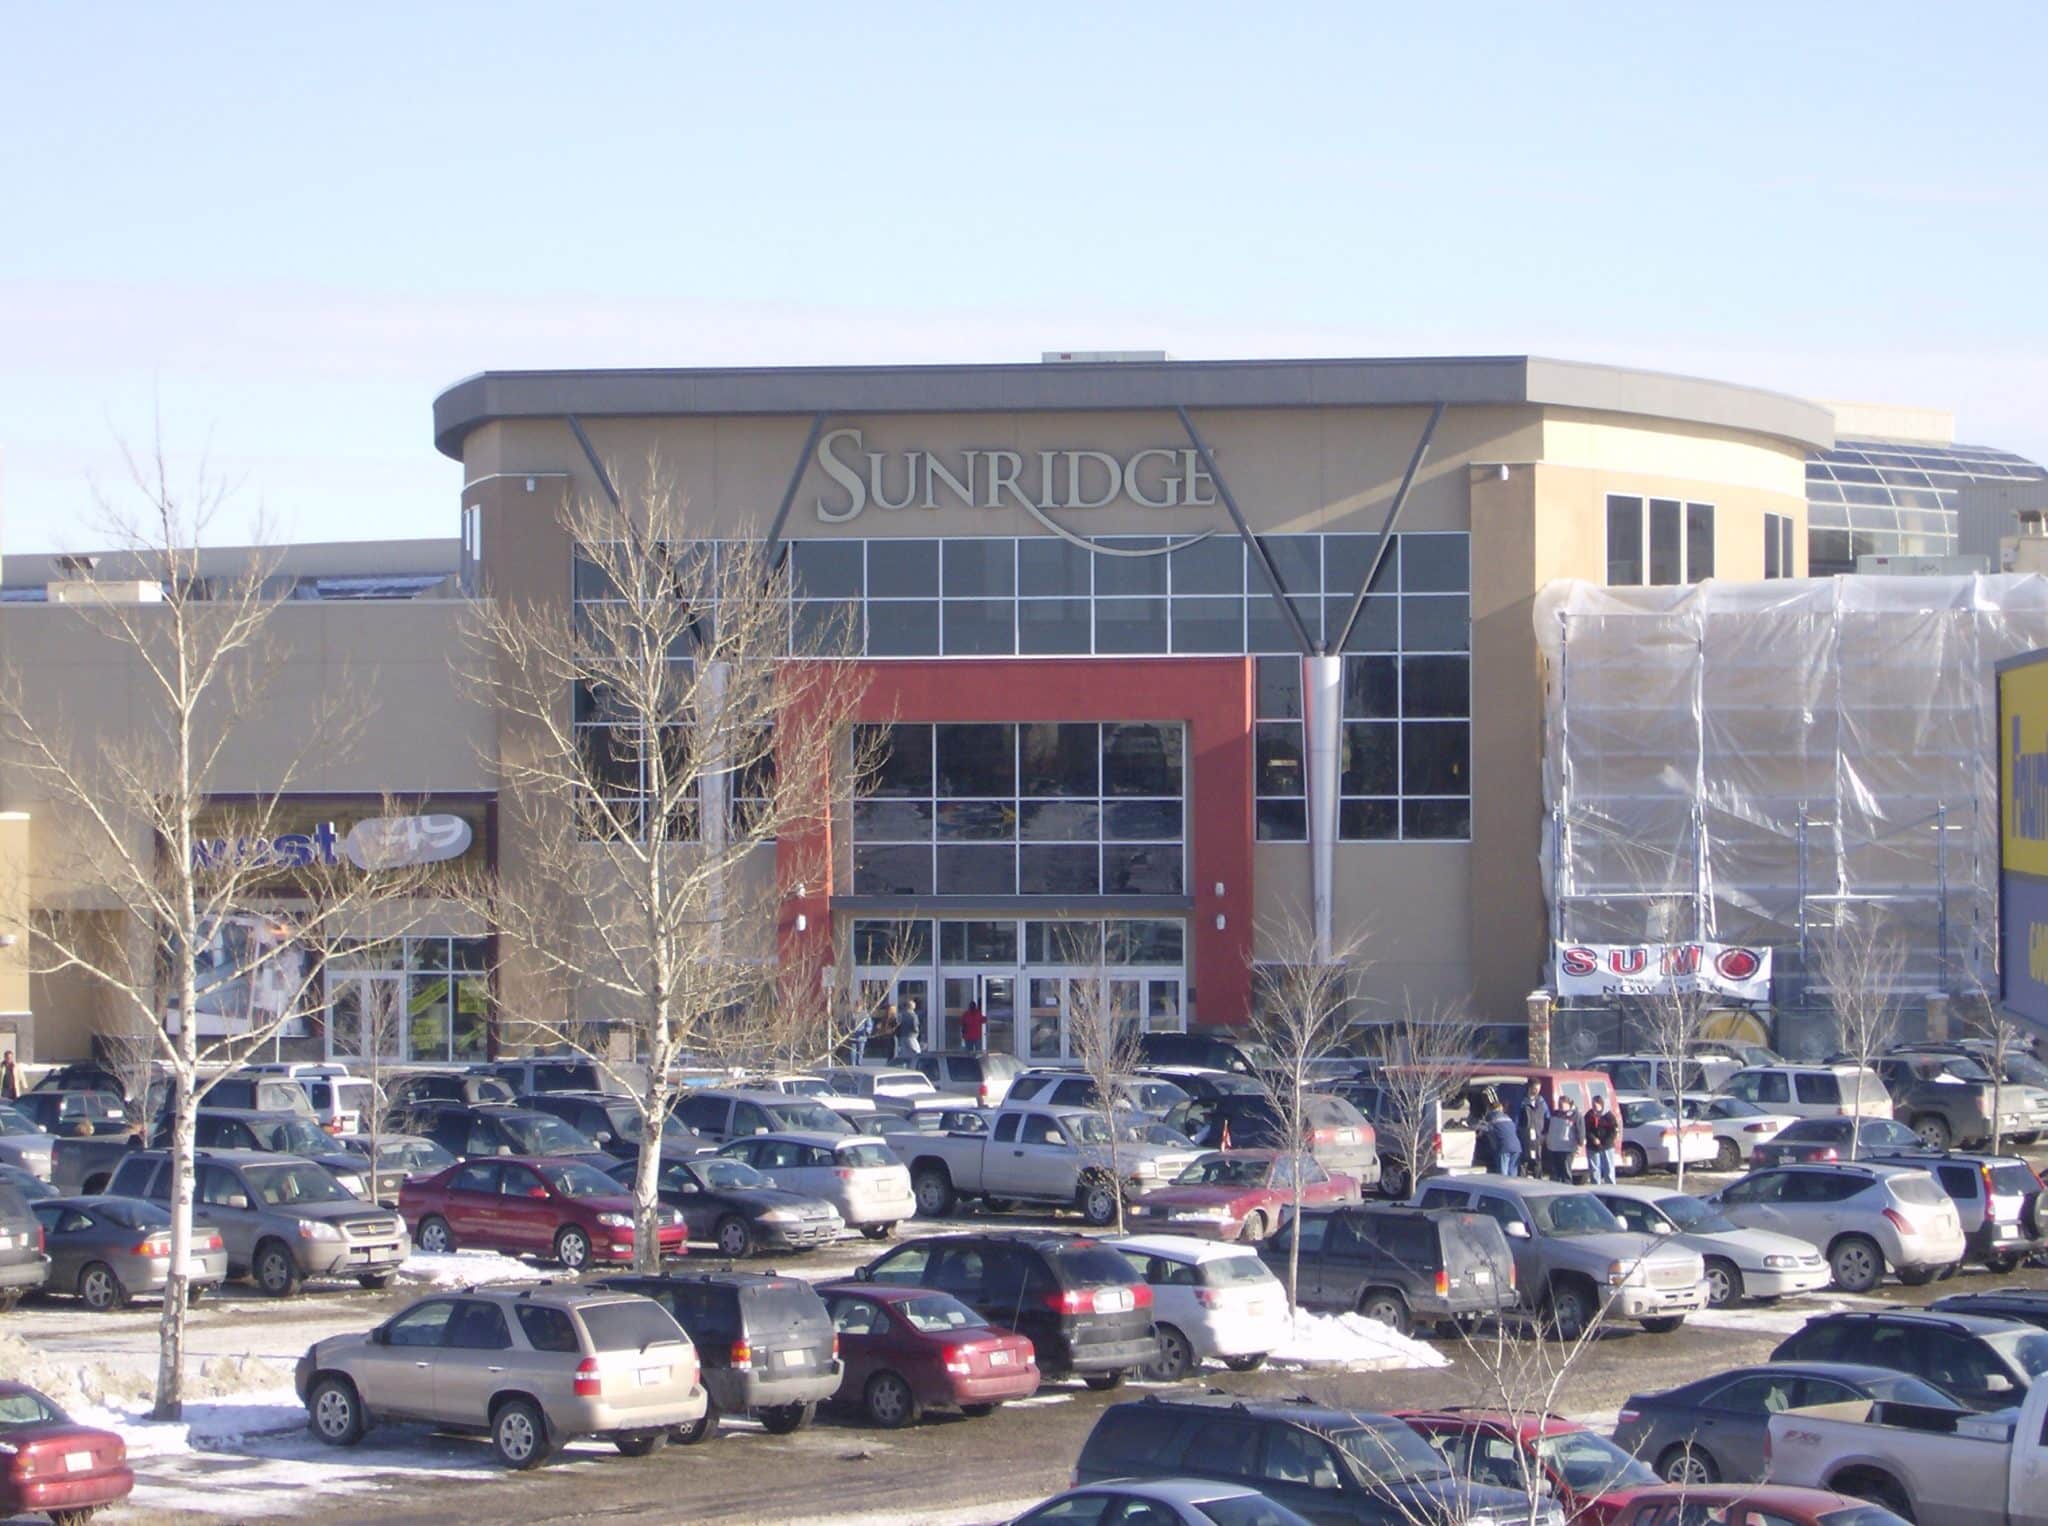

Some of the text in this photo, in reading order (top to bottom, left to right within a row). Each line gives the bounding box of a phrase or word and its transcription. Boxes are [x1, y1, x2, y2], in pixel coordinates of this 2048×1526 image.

[816, 429, 1217, 556] SUNRIDGE
[1563, 945, 1761, 981] SUMO
[1602, 985, 1656, 994] NOW
